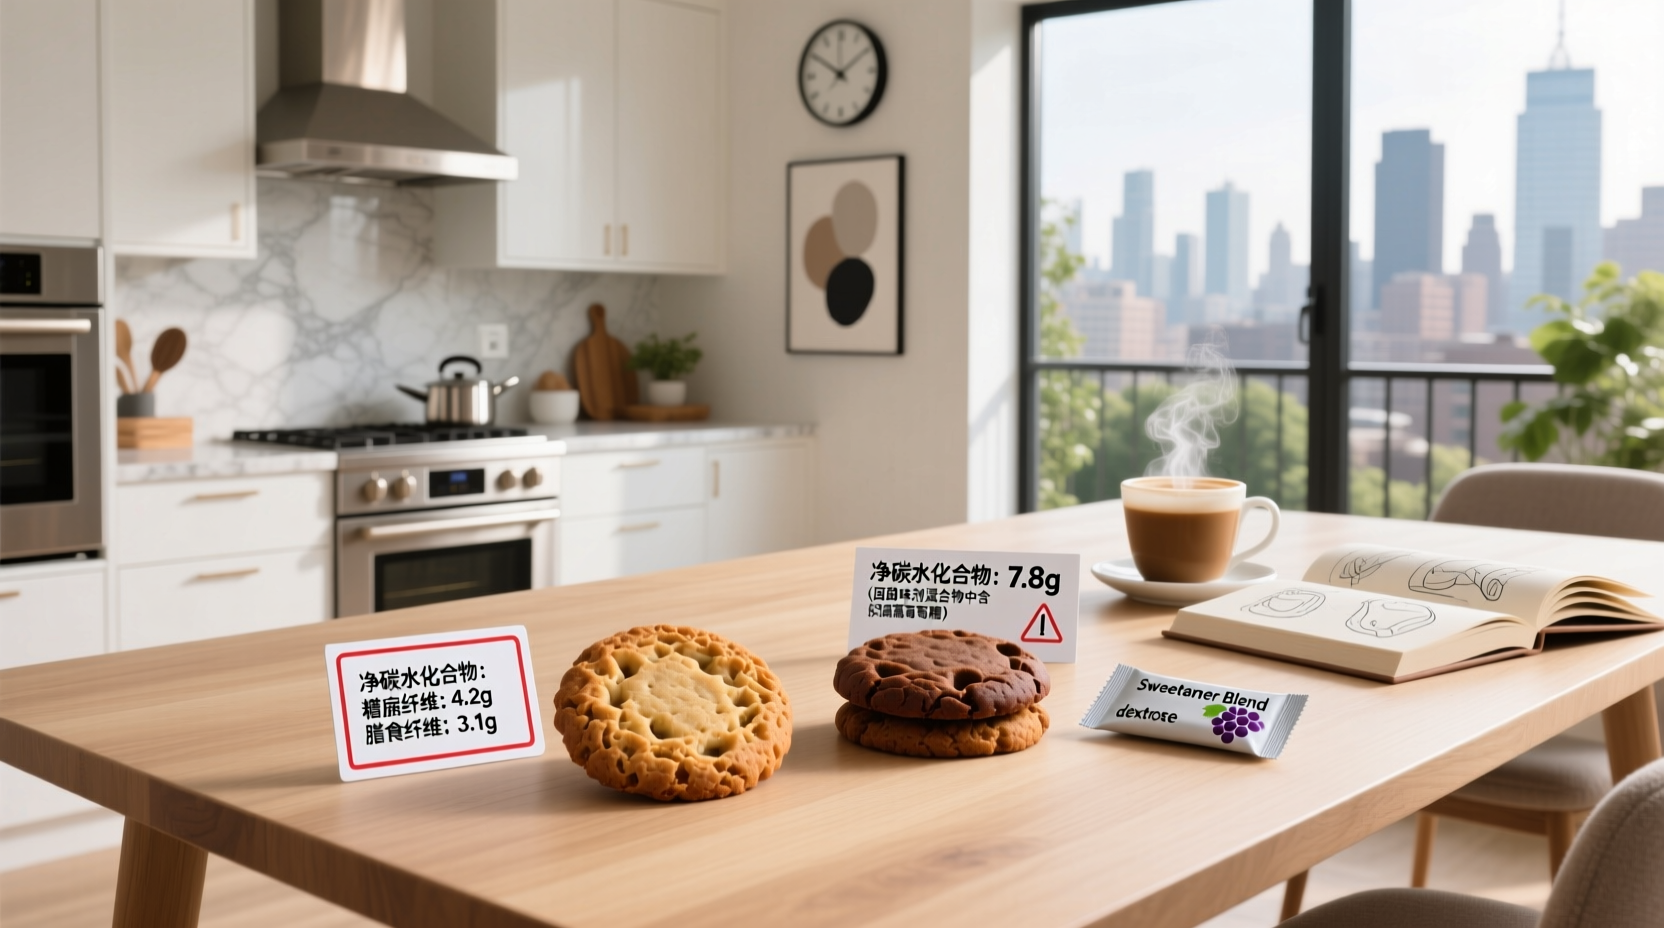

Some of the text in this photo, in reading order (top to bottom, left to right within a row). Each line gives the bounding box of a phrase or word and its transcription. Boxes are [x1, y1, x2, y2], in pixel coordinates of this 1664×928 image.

[1009, 566, 1060, 597] 7.8g
[451, 688, 493, 708] 4.2g
[1222, 691, 1270, 712] Blend
[457, 713, 498, 735] 3.1g
[1115, 703, 1178, 724] dextrose
